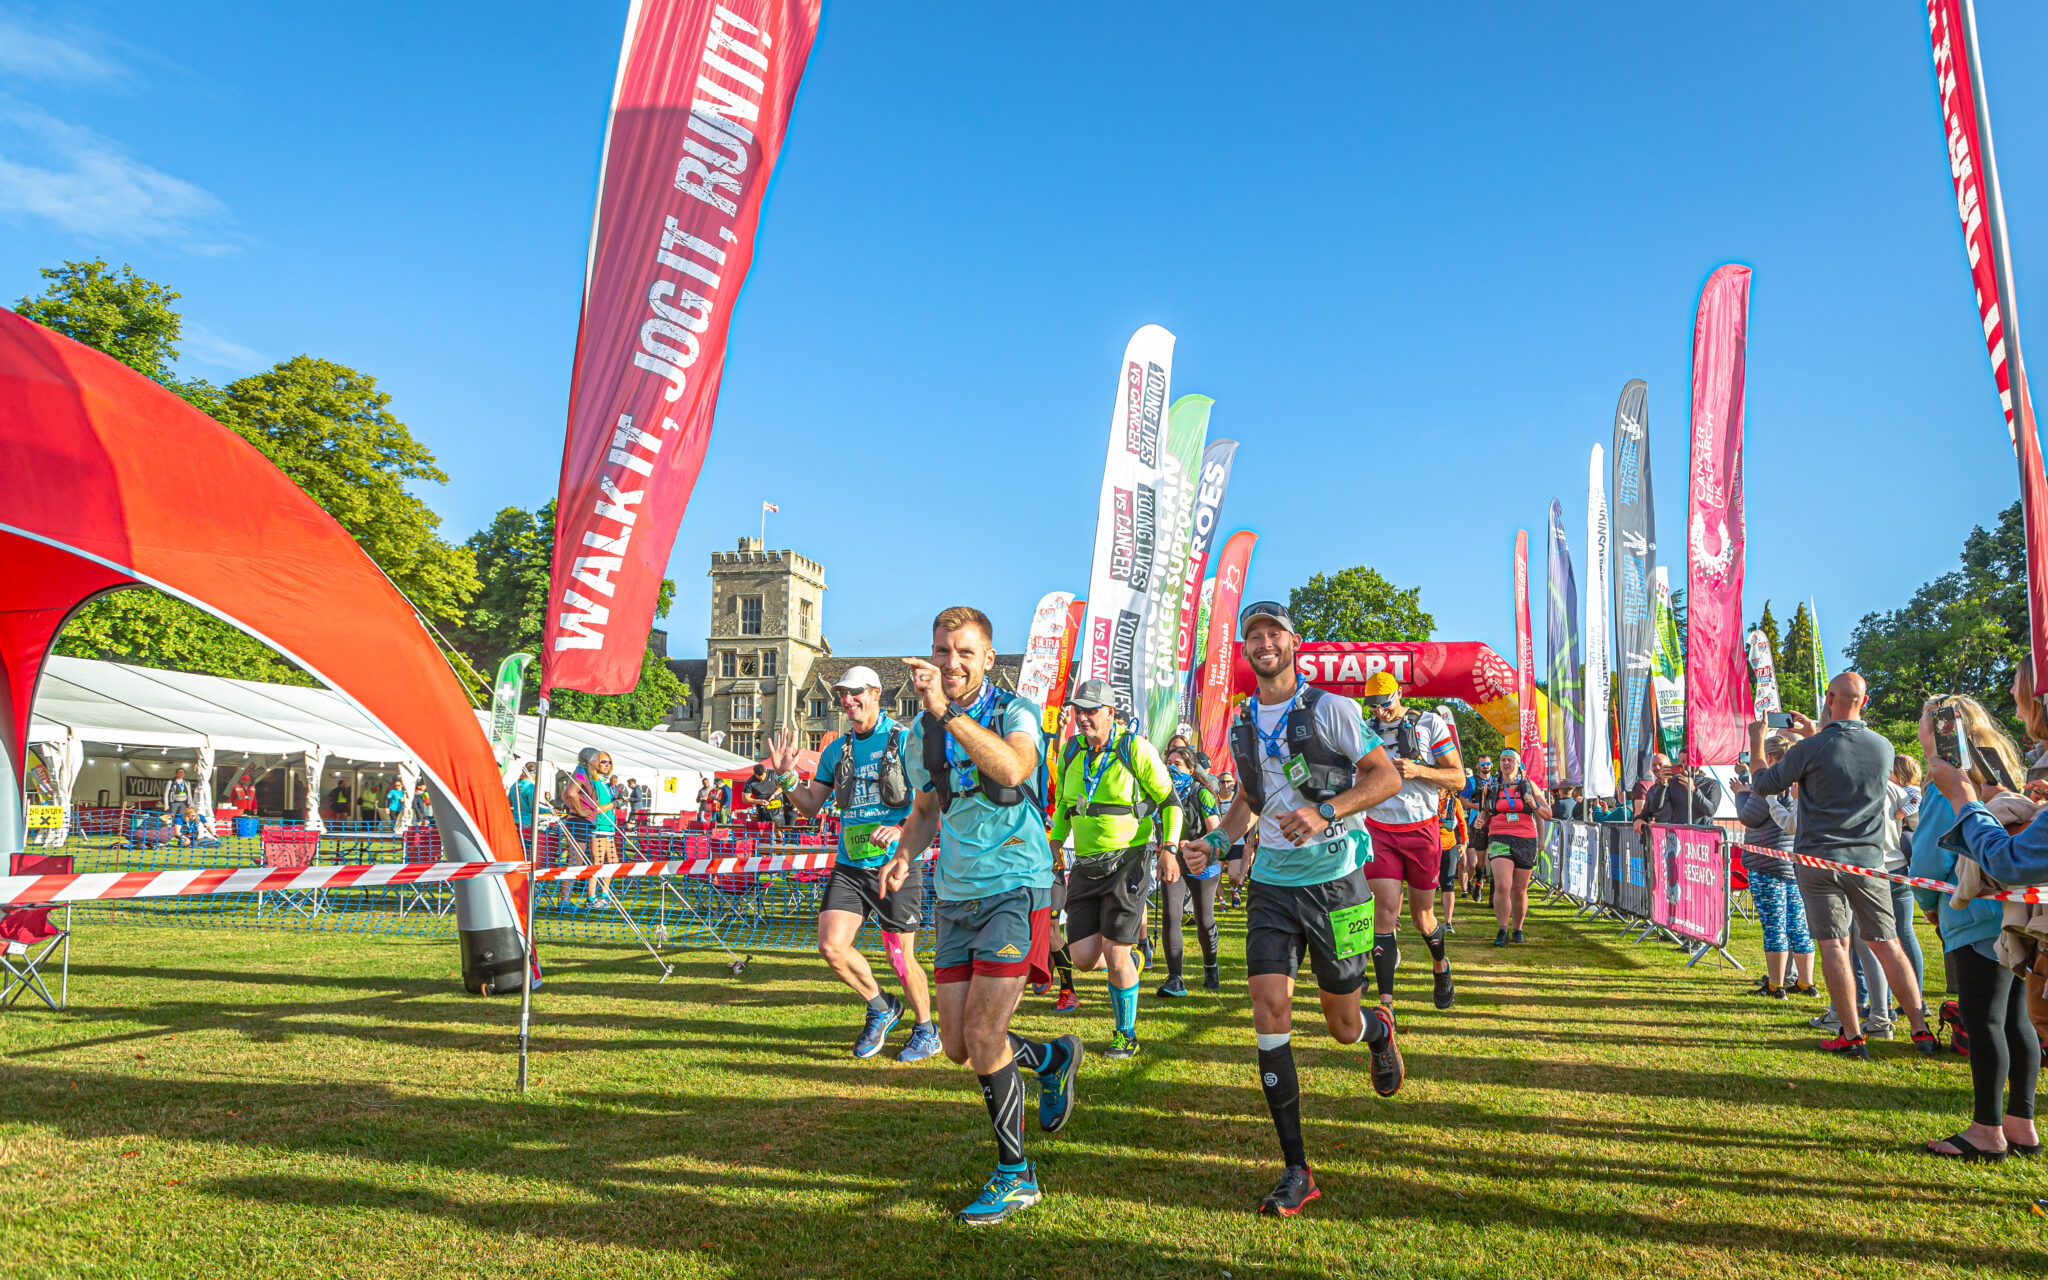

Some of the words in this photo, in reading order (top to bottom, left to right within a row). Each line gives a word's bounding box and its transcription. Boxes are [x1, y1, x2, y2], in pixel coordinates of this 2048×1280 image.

[703, 3, 773, 95] IT!
[674, 74, 760, 218] RUN
[656, 217, 738, 285] IT,
[634, 280, 714, 403] JOG
[1127, 388, 1141, 454] CANCER
[1143, 370, 1165, 422] YOUNG
[608, 414, 680, 481] IT,
[1139, 424, 1157, 466] LIVES
[1696, 426, 1706, 501] CANCER
[1703, 412, 1715, 506] RESEARCH
[1137, 489, 1154, 541] YOUNG
[1714, 484, 1724, 508] UK
[1112, 515, 1133, 579] CANCER
[1181, 461, 1225, 610] HEROES
[555, 475, 643, 652] WALK
[1131, 543, 1153, 589] LIVES
[1156, 592, 1178, 688] CANCER
[1167, 473, 1195, 587] SUPPORT
[1623, 554, 1638, 606] CANCER
[1634, 557, 1650, 622] PROSTATE
[1112, 617, 1138, 669] YOUNG
[1625, 608, 1639, 626] UK
[1035, 638, 1060, 649] ULTRA
[1091, 645, 1109, 684] CAN
[1215, 622, 1230, 686] Heartbreak
[1298, 654, 1409, 682] START
[1111, 672, 1132, 714] LIVES
[1208, 664, 1218, 686] Beat
[492, 703, 505, 742] WELFARE
[503, 712, 515, 735] AREA
[1627, 677, 1642, 729] CANCER
[860, 763, 879, 772] WEST
[859, 808, 890, 817] Finisher
[850, 833, 871, 845] 1057
[1327, 838, 1348, 855] on
[1348, 917, 1373, 935] 2291
